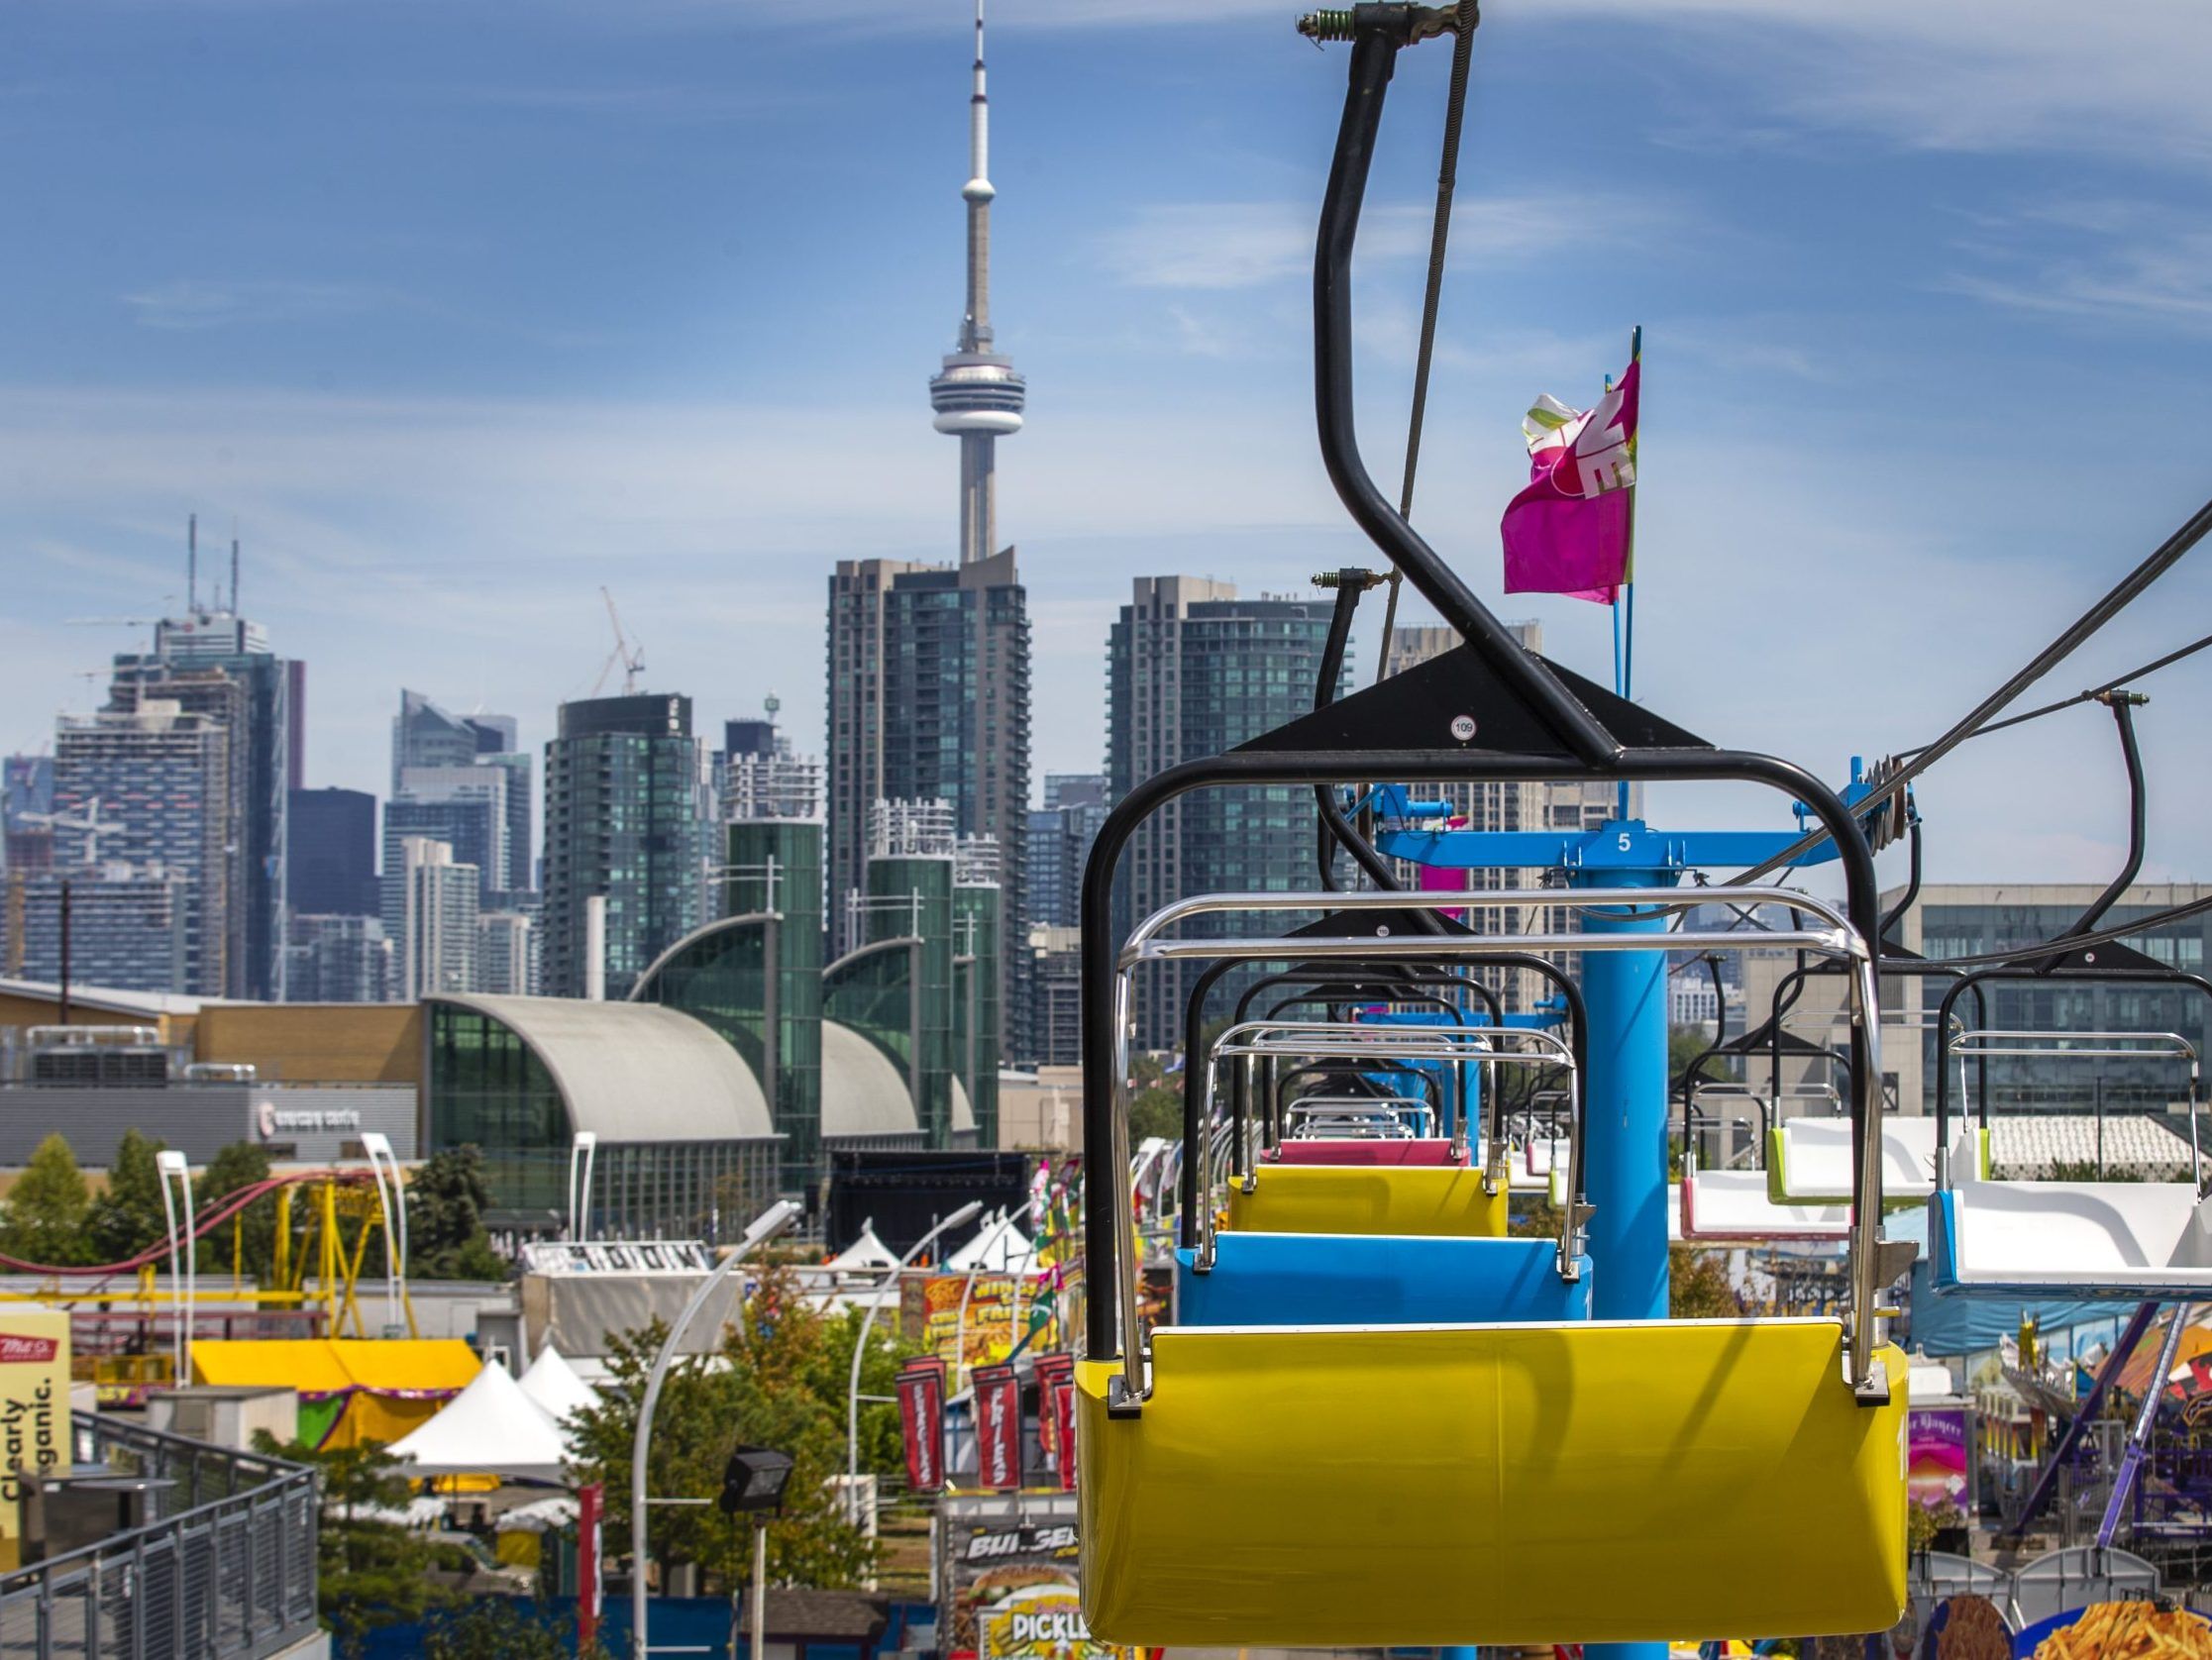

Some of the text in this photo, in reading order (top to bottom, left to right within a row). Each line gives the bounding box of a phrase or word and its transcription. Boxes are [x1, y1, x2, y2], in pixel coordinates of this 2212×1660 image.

[1456, 722, 1474, 733] 109
[1618, 832, 1632, 852] 5
[1, 1398, 29, 1502] Clearly
[991, 1386, 1006, 1485] FRIES
